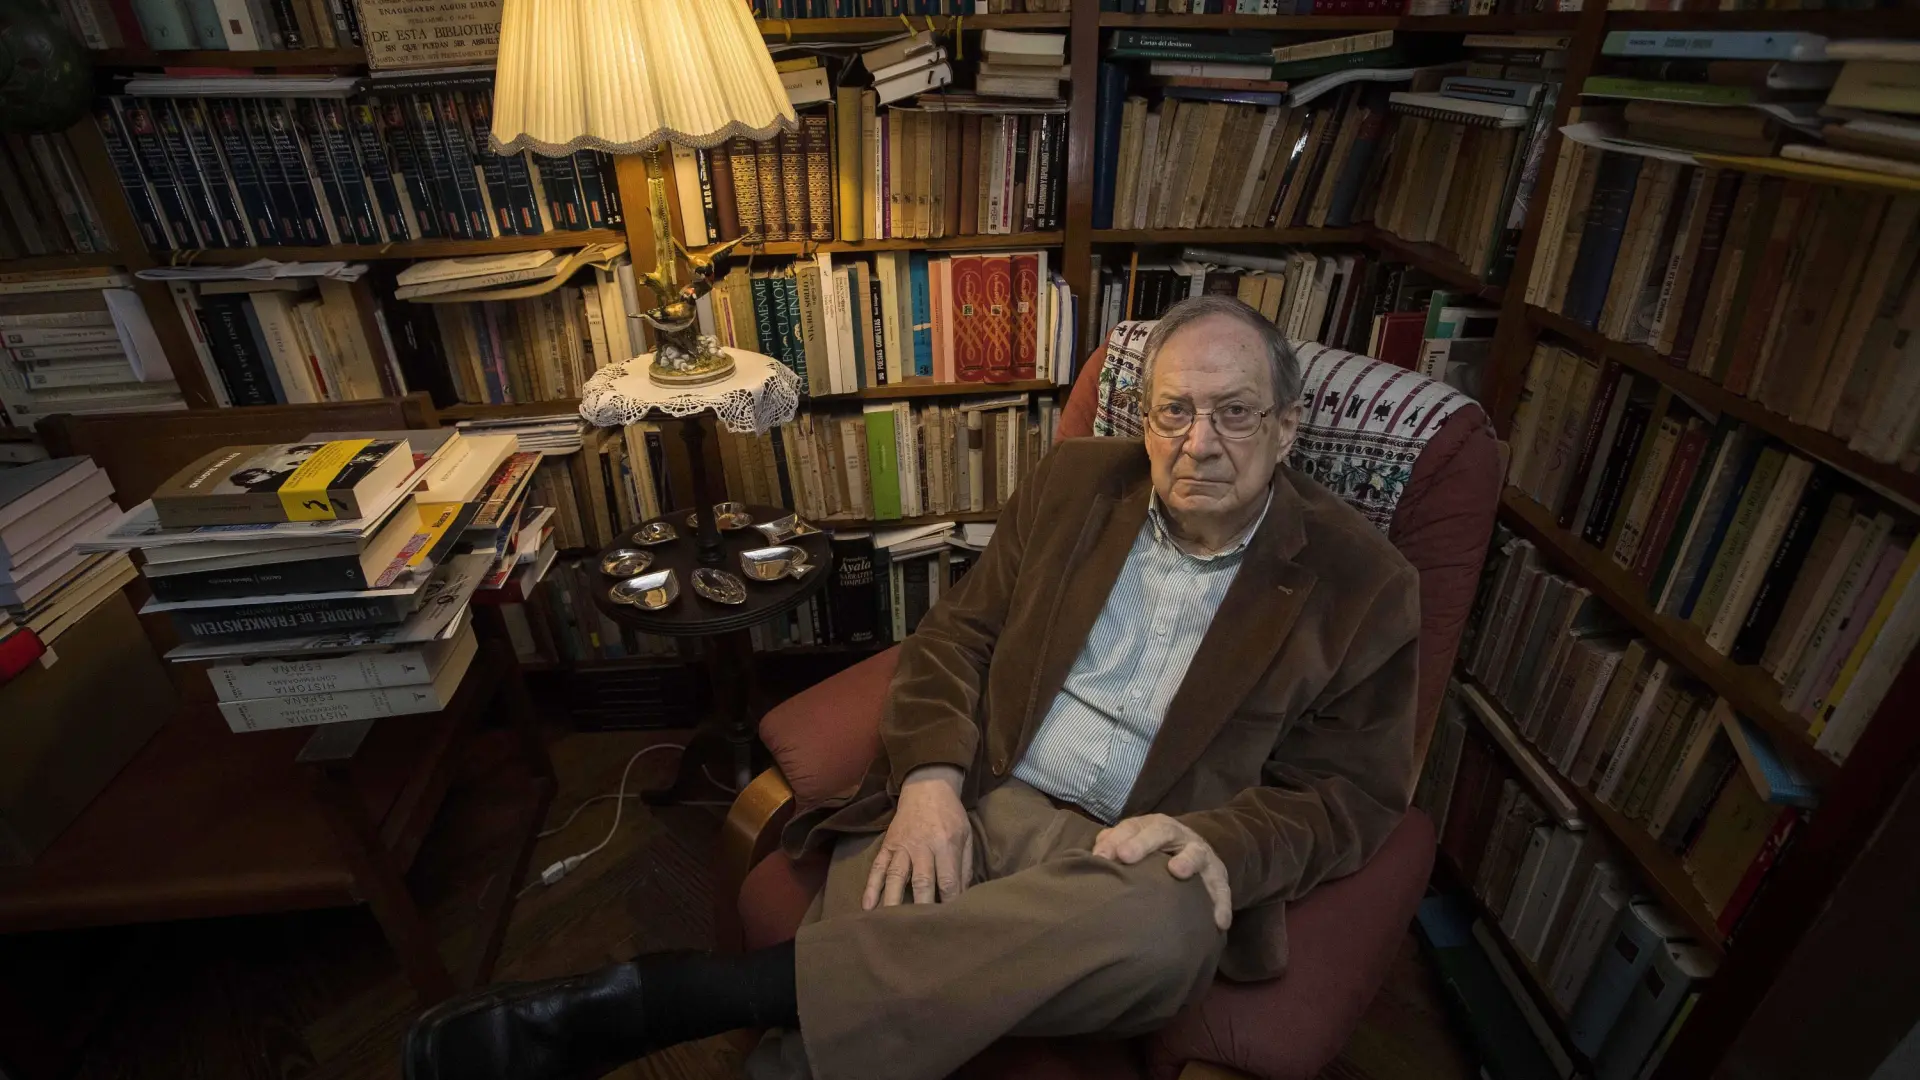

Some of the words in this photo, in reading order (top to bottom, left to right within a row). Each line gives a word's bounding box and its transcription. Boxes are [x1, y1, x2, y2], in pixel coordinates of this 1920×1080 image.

[439, 3, 467, 12] ALGUN
[471, 1, 497, 9] LIBRO
[372, 30, 391, 42] DE
[396, 28, 427, 40] ESTA
[434, 22, 502, 38] BIBLIOTHEC
[386, 44, 396, 52] SIN
[402, 44, 418, 52] QUE
[422, 41, 449, 50] PUEDAN
[472, 38, 500, 46] ABSUELT
[1040, 152, 1049, 179] APOLONIO
[1038, 183, 1046, 214] BELARMINO
[772, 280, 790, 339] CLAMOR
[232, 344, 250, 368] vega
[1426, 350, 1445, 377] litor
[839, 560, 872, 573] Ayala
[299, 611, 314, 624] DE
[316, 606, 367, 624] MADRE
[367, 604, 382, 618] LA
[190, 613, 296, 637] FRANKENSTEIN
[270, 662, 322, 675] ESPAÑA
[274, 682, 336, 695] HISTORIA
[288, 711, 348, 724] HISTORIA
